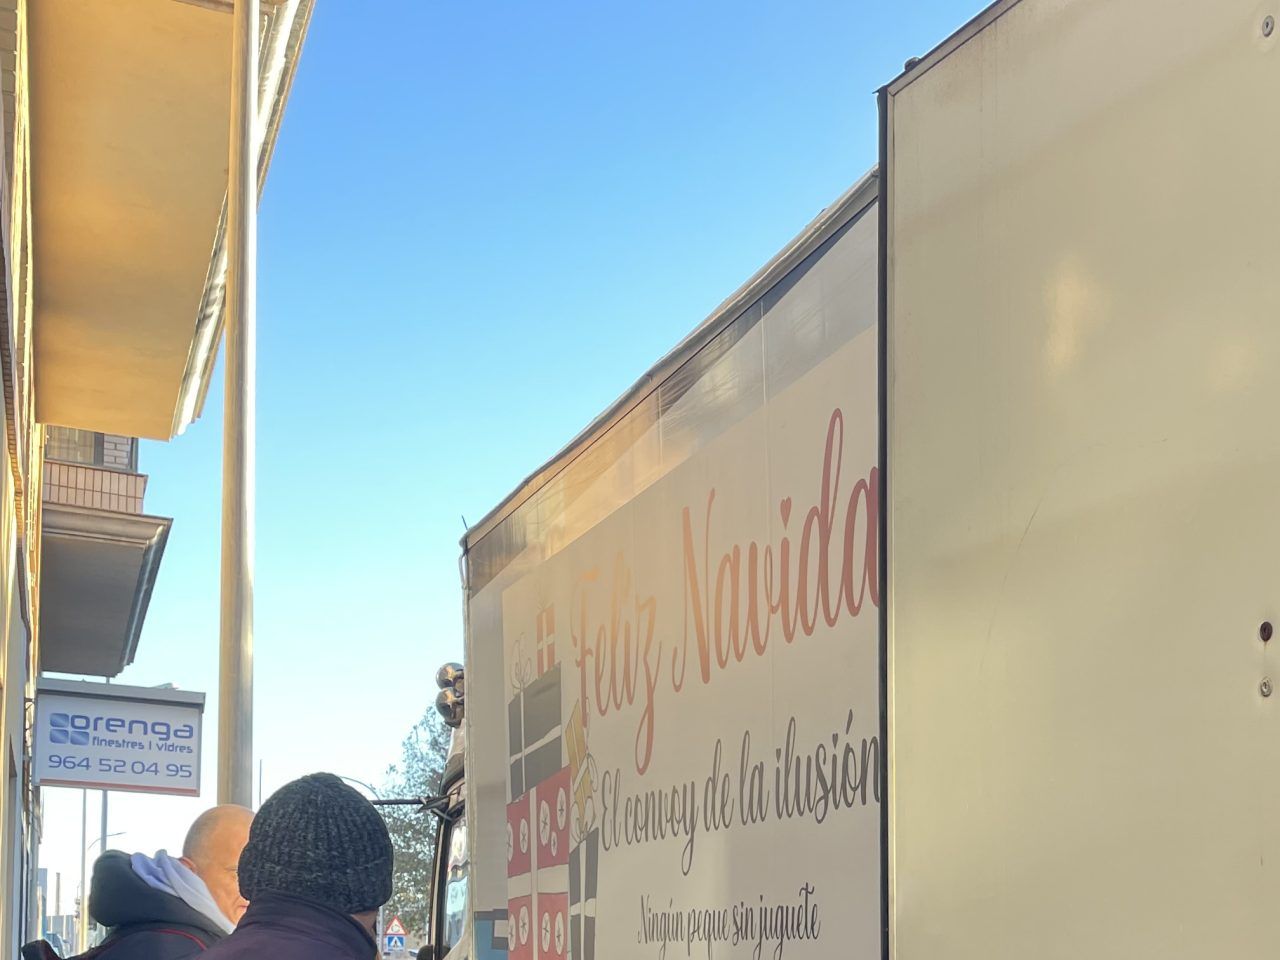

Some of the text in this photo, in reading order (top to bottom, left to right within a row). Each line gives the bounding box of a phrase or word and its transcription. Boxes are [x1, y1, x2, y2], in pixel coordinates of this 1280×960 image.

[570, 550, 662, 776] Feliz
[70, 714, 194, 741] orenga
[92, 736, 145, 750] finestres
[156, 742, 193, 754] vidres
[48, 754, 192, 778] 964 52 04 95
[601, 709, 880, 876] El convoy de la ilusión
[732, 901, 756, 946] sin
